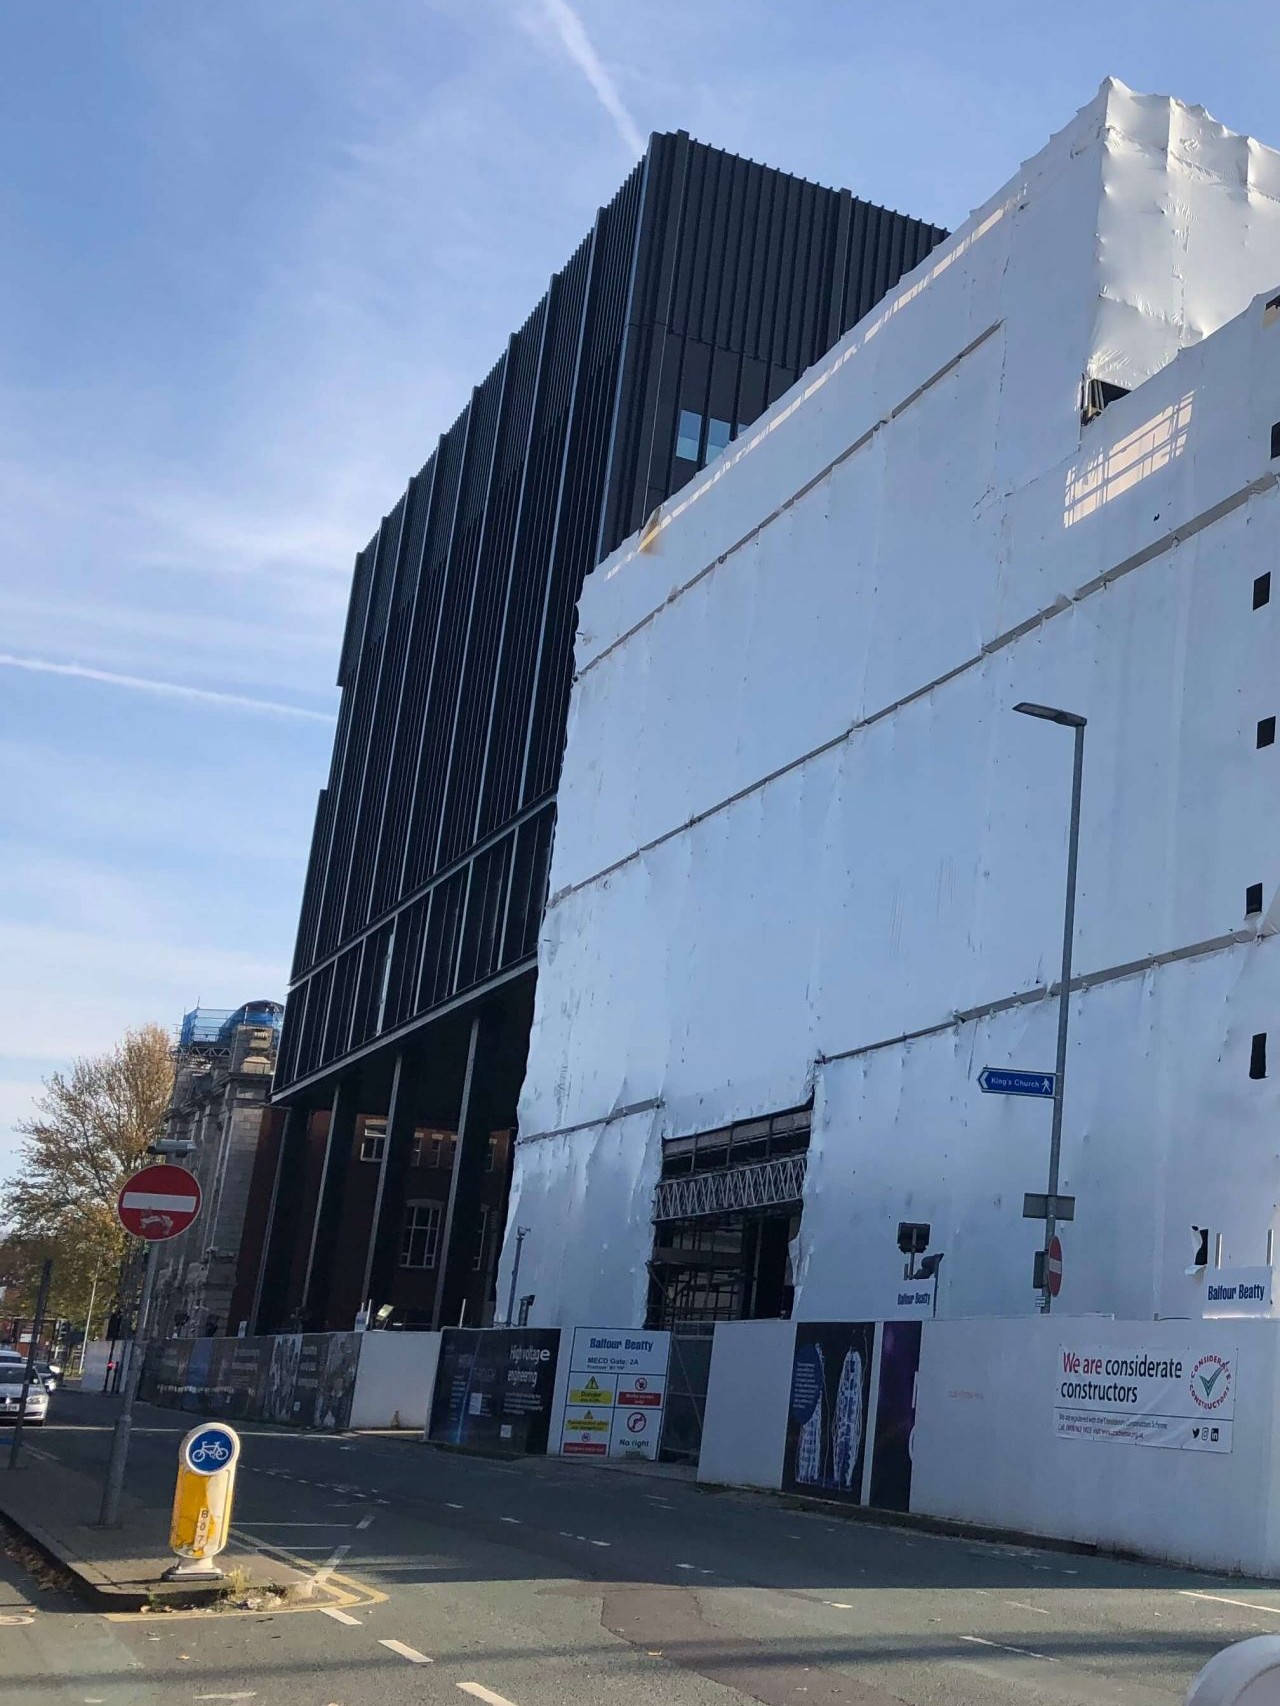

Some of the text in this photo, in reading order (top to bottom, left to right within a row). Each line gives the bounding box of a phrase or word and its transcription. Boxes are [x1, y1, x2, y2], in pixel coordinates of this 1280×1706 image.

[991, 1077, 1040, 1088] King's Church
[1208, 1283, 1265, 1301] Balfour Beatty
[589, 1337, 654, 1352] Balfour Beatty
[1063, 1352, 1182, 1379] We are considerate
[1190, 1355, 1232, 1379] CONSIDERATE
[1061, 1381, 1138, 1403] constructors
[620, 1439, 650, 1448] No right
